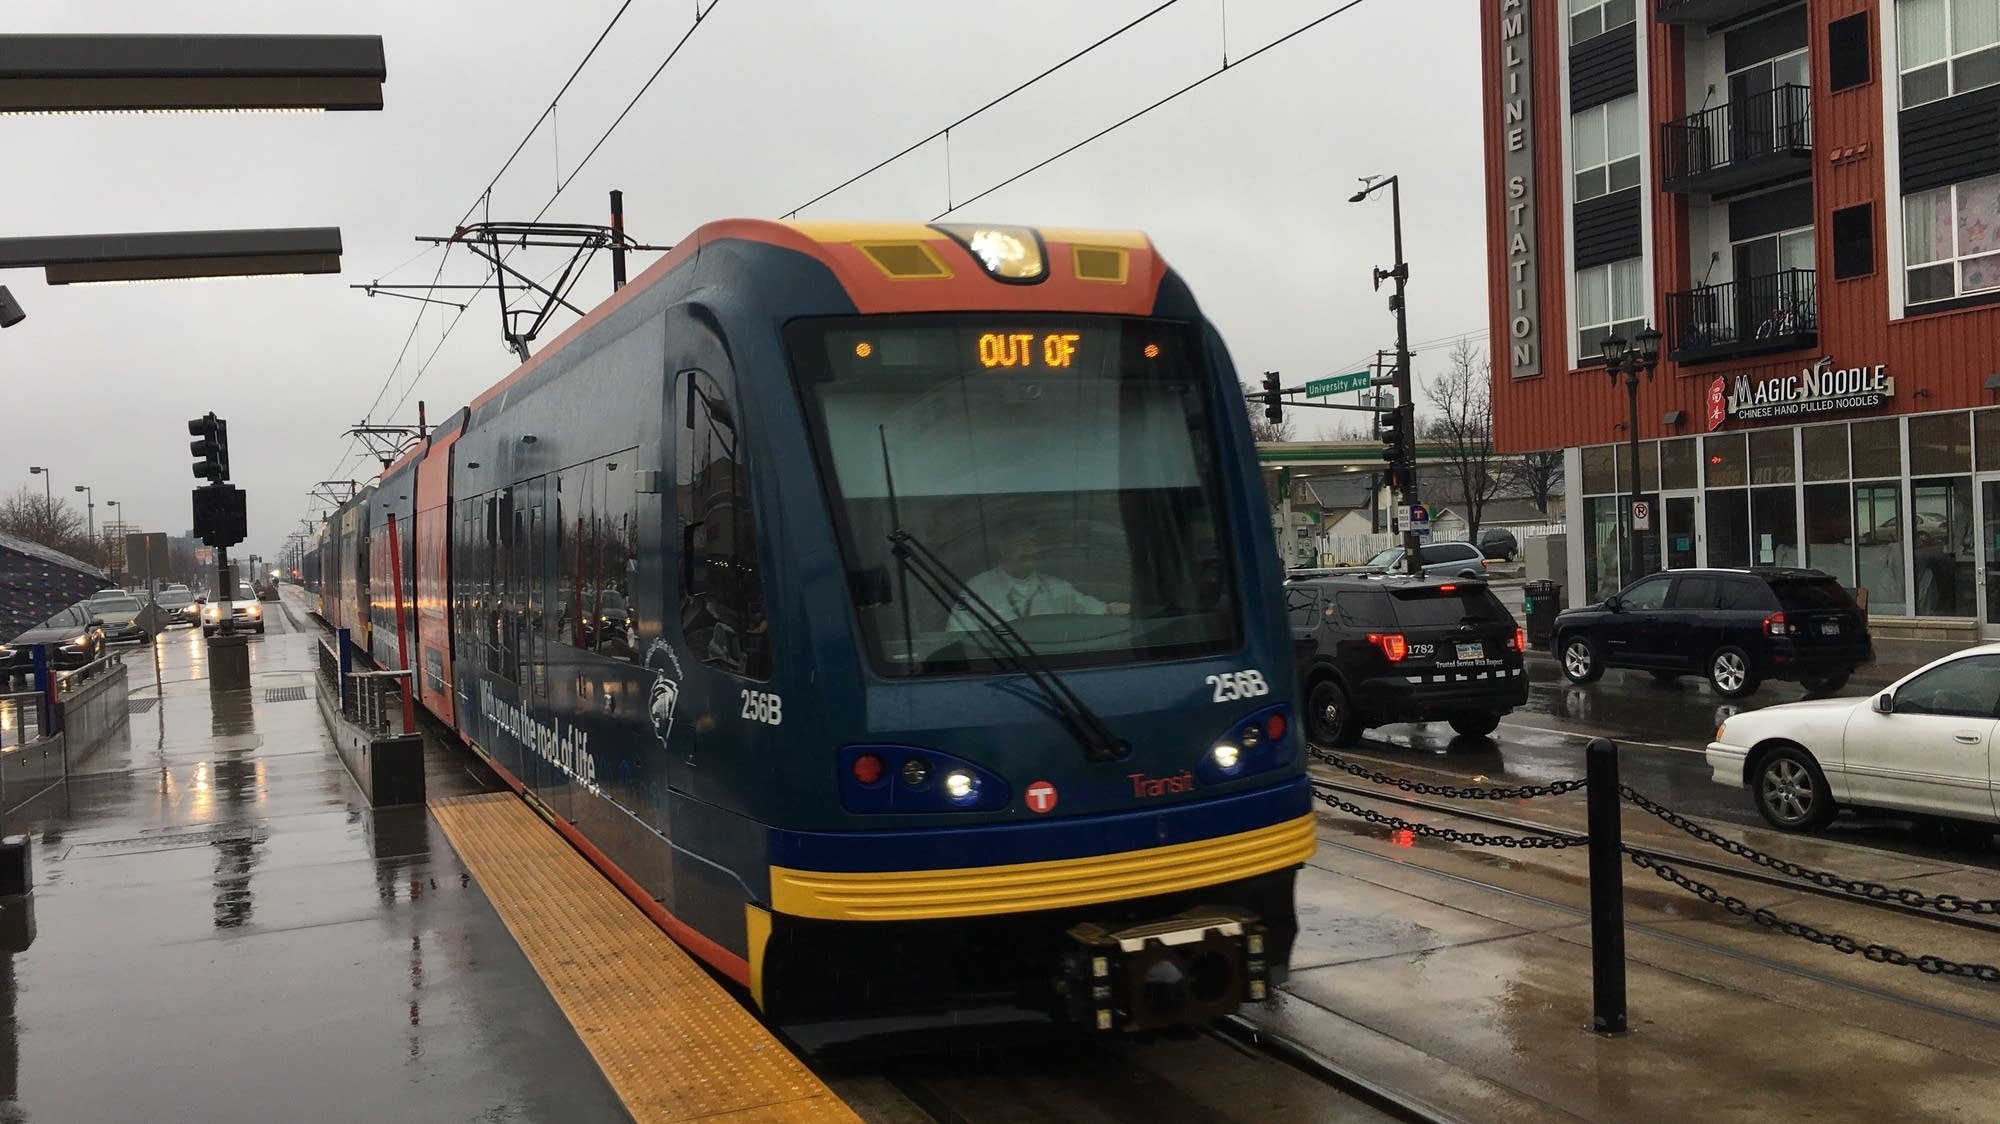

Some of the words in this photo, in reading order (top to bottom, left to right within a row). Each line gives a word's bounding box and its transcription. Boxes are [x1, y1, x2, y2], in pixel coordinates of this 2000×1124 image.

[1509, 176, 1531, 366] STATION
[979, 334, 1034, 367] OUT
[1043, 334, 1080, 367] OF
[1308, 380, 1349, 395] University
[1352, 377, 1367, 388] Ave
[1733, 374, 1797, 407] MAGIC
[1799, 357, 1886, 399] NOODLE
[1738, 406, 1772, 419] CHINESE
[1774, 404, 1798, 416] HAND
[1800, 400, 1833, 413] PULLED
[1836, 396, 1879, 409] NOODLES
[1407, 644, 1434, 654] 1782
[1205, 669, 1269, 703] 256B
[741, 689, 782, 725] 256B
[520, 700, 537, 752] the
[537, 717, 559, 768] road
[561, 724, 573, 777] of
[1028, 787, 1054, 809] T
[1127, 769, 1196, 799] Transit
